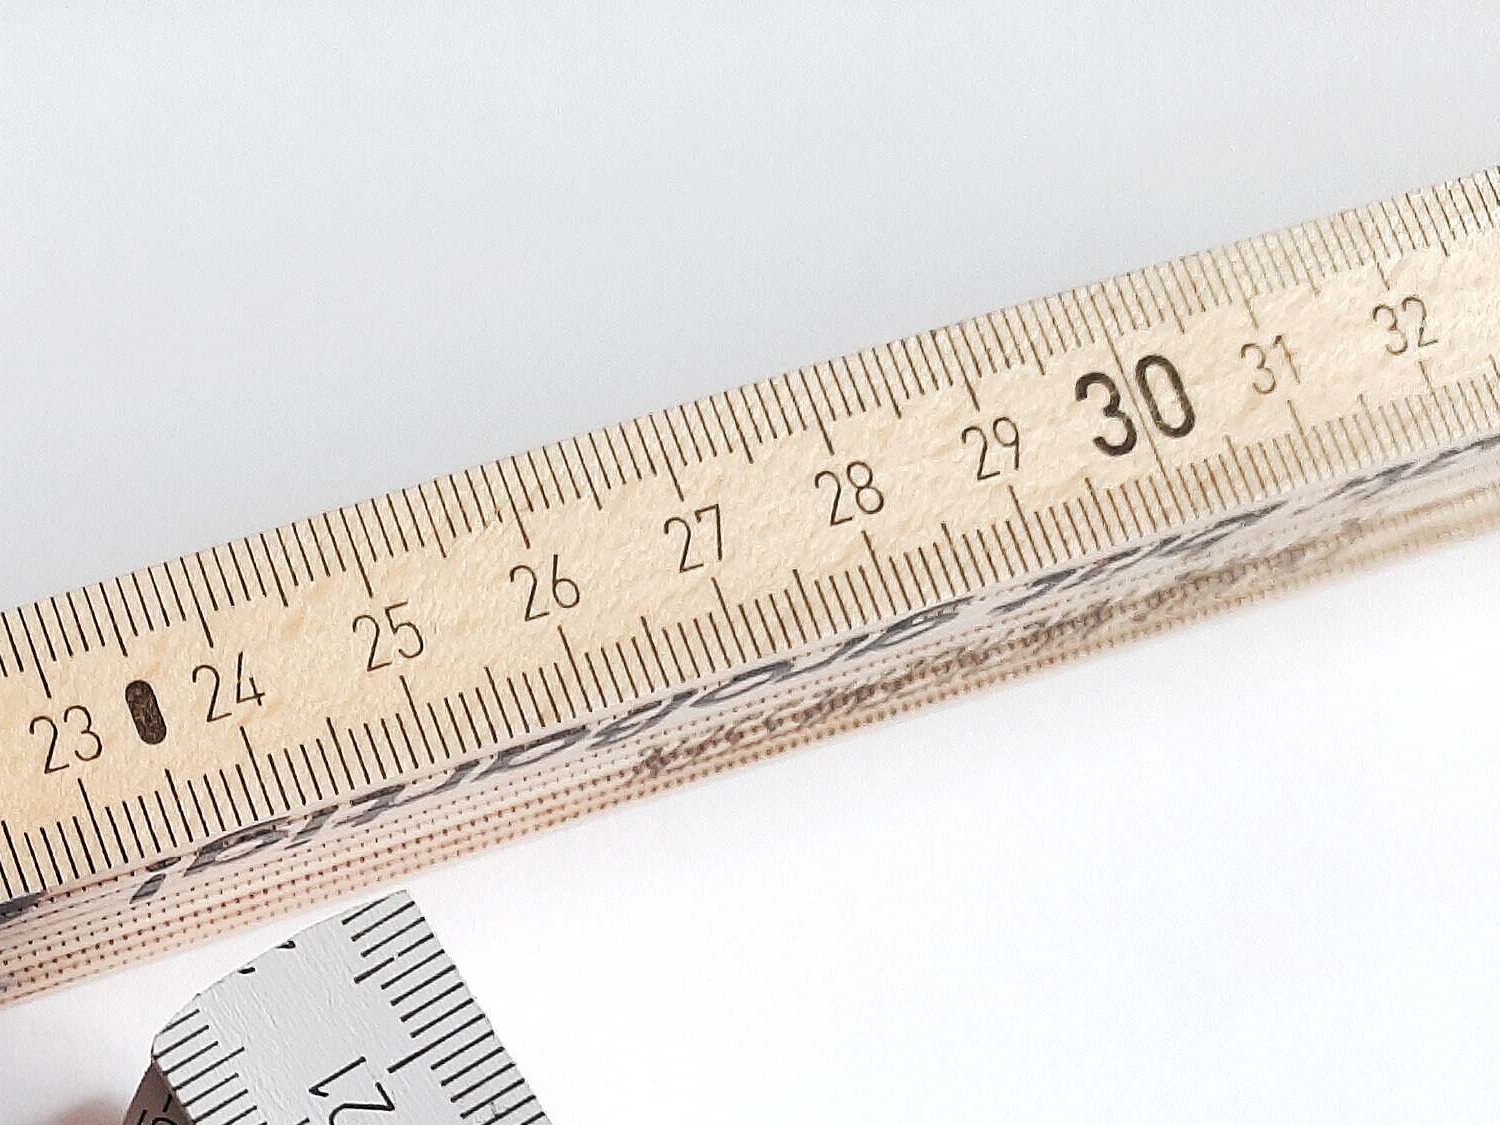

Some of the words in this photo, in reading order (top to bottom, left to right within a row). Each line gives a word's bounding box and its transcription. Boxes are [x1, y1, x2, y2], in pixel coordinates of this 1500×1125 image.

[1371, 296, 1440, 356] 32
[1240, 334, 1300, 395] 31
[1074, 354, 1197, 456] 30
[962, 416, 1022, 482] 29
[814, 460, 886, 527] 28
[663, 506, 725, 573] 27
[509, 554, 581, 622] 26
[352, 601, 424, 671] 25
[192, 652, 265, 723] 24
[29, 705, 102, 774] 23
